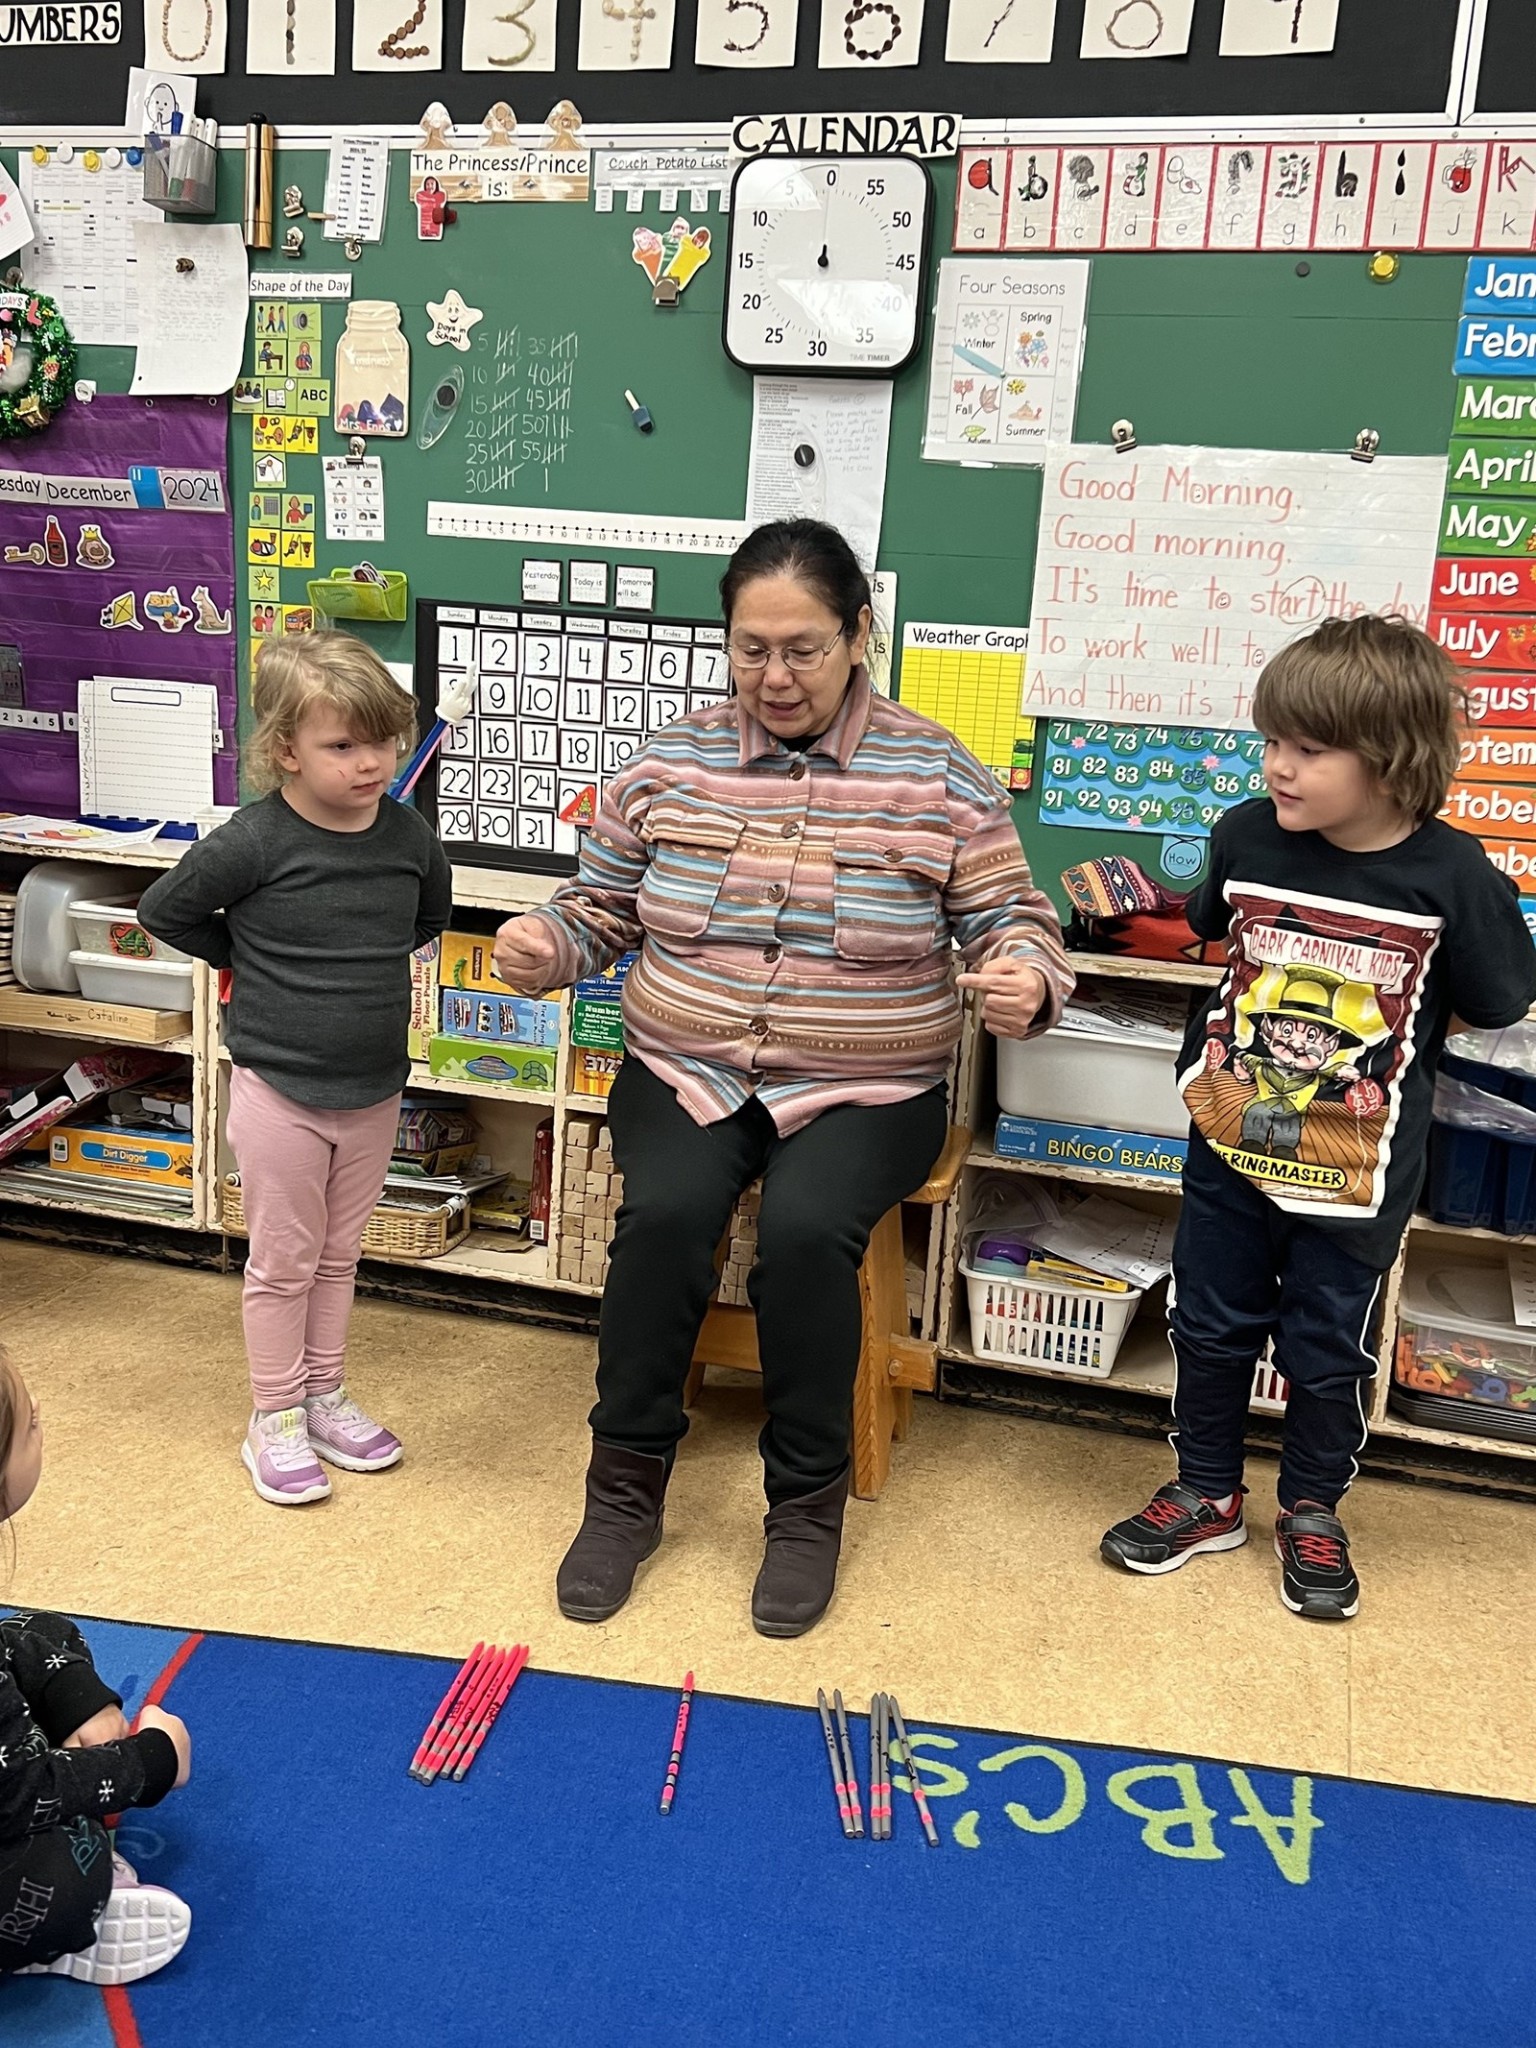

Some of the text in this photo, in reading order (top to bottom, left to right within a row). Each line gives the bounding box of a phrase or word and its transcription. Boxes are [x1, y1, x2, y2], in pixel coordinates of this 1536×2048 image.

[733, 115, 956, 153] CALENDAR
[412, 154, 588, 173] The Princess/Prince
[609, 155, 728, 170] Couch Potato List
[826, 170, 837, 186] 0
[867, 180, 885, 195] 55
[487, 179, 508, 197] is:
[785, 180, 795, 196] 5
[752, 211, 768, 227] 10
[892, 212, 912, 228] 50
[973, 212, 1517, 245] a b c d e f g h k
[738, 253, 753, 268] 15
[895, 255, 915, 270] 45
[251, 279, 350, 295] Shape of the Day
[959, 274, 1066, 296] Four Seasons
[742, 294, 761, 310] 20
[882, 295, 902, 311] 40
[437, 322, 456, 333] Days
[1020, 312, 1052, 324] Spring
[435, 331, 462, 343] School
[478, 333, 489, 351] 5
[765, 328, 784, 343] 25
[855, 327, 874, 343] 35
[964, 338, 996, 349] Winter
[528, 338, 546, 355] 35
[808, 341, 828, 357] 30
[866, 354, 890, 362] TIMER
[472, 365, 487, 384] 10
[528, 364, 549, 385] 40
[301, 389, 327, 401] ABC
[470, 394, 488, 414] 15
[526, 388, 544, 410] 45
[955, 404, 973, 415] Fall
[465, 420, 486, 438] 20
[522, 414, 544, 435] 50
[1005, 424, 1046, 436] Summer
[466, 444, 487, 464] 25
[521, 440, 541, 461] 55
[46, 482, 132, 502] December
[133, 468, 142, 481] 11
[163, 477, 220, 502] 2024
[465, 469, 487, 494] 30
[1059, 460, 1302, 523] Good Morning.
[1446, 504, 1528, 547] May
[1055, 514, 1292, 577] Good morning.
[525, 571, 559, 580] Yesterday
[574, 578, 594, 587] Today
[1439, 563, 1520, 597] June
[872, 578, 884, 593] is
[1048, 566, 1366, 618] It's time to start the
[530, 617, 552, 627] Tuesday
[615, 624, 642, 635] Thursday
[662, 629, 681, 638] Friday
[913, 627, 980, 646] Weather
[1036, 617, 1265, 668] To work well, to
[1435, 618, 1500, 659] July
[452, 635, 716, 683] 1 2 3 4 5 6 7
[1027, 670, 1212, 716] And then it's
[490, 682, 677, 727] 9 10 11 12 13
[17, 715, 74, 726] 3 4 5 6
[449, 724, 468, 750] 15
[486, 727, 510, 754] 16
[531, 730, 549, 756] 17
[568, 737, 590, 764] 18
[1053, 723, 1237, 751] 71 72 73 74 76
[441, 766, 552, 802] 22 23 24
[1052, 758, 1071, 775] 81
[1082, 757, 1107, 774] 82
[1114, 766, 1139, 784] 83
[1149, 760, 1174, 778] 84
[1214, 777, 1239, 794] 86
[1045, 790, 1063, 807] 91
[1078, 790, 1101, 808] 92
[1107, 799, 1131, 816] 93
[1138, 800, 1162, 818] 94
[1201, 807, 1224, 824] 96
[441, 809, 545, 845] 29 30 31
[1168, 853, 1197, 866] How
[1252, 927, 1402, 980] DARK CARNIVAL KIDS
[423, 967, 431, 998] Puzzle
[412, 987, 422, 1030] School
[423, 1000, 431, 1025] Floor
[585, 1004, 620, 1016] Number
[103, 1149, 148, 1162] Dirt Digger
[1047, 1139, 1114, 1163] BINGO
[1120, 1149, 1184, 1173] BEARS
[1230, 1153, 1341, 1186] RINGMASTER
[891, 1733, 1325, 1885] ABC's
